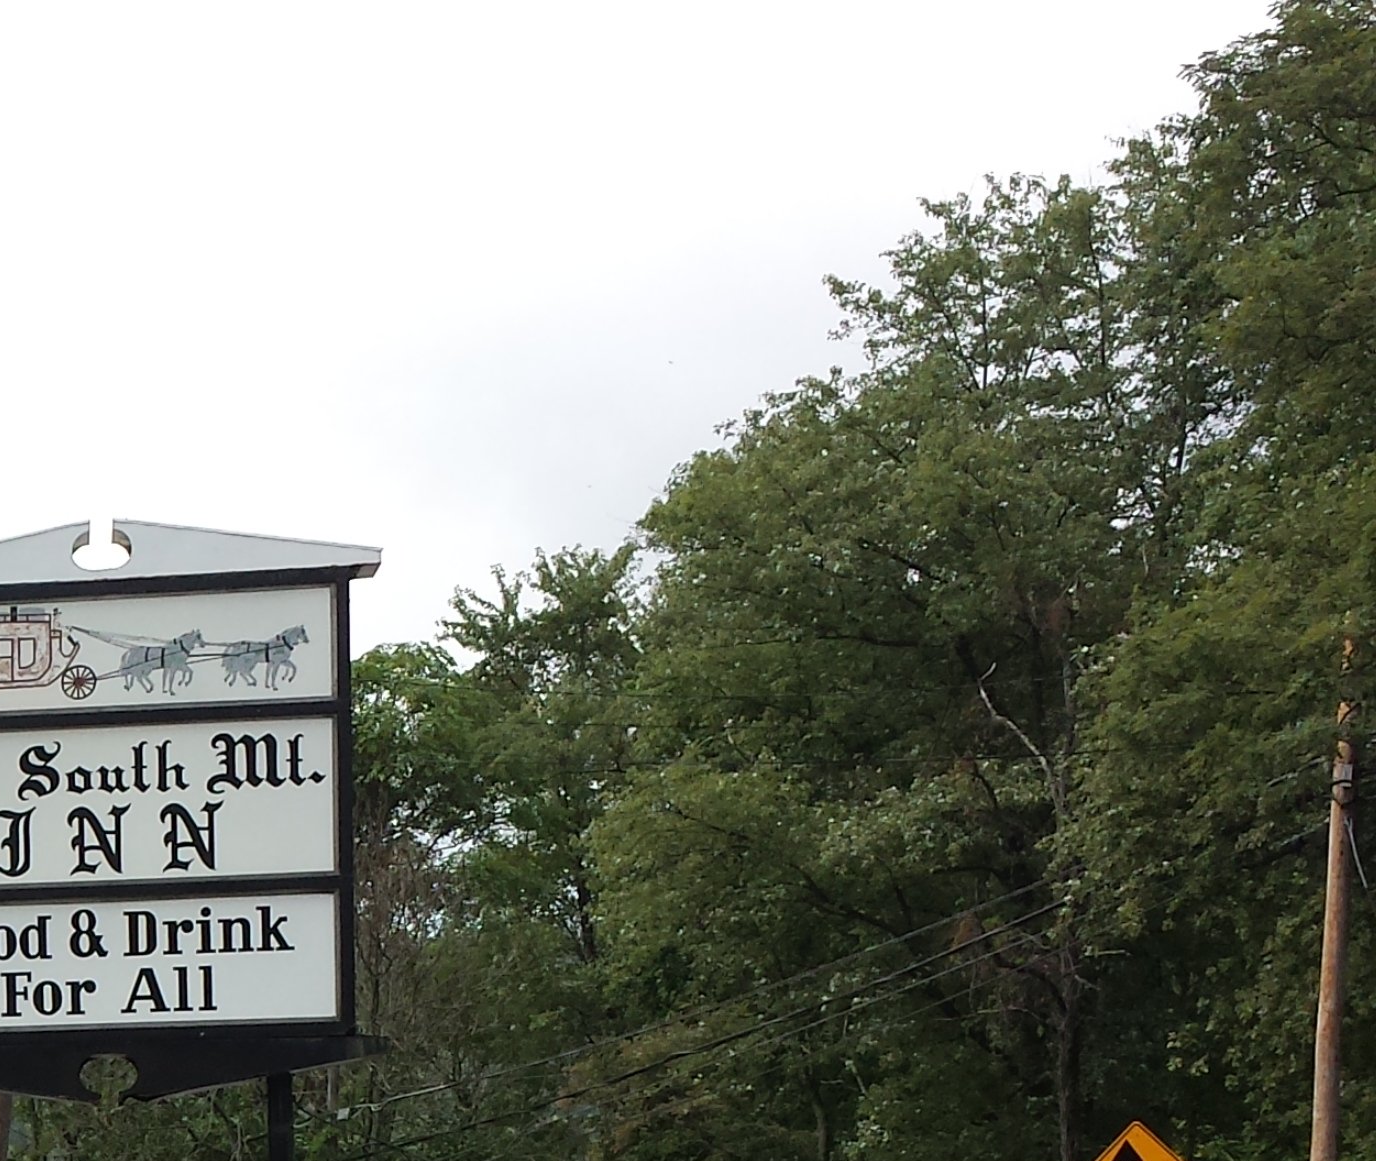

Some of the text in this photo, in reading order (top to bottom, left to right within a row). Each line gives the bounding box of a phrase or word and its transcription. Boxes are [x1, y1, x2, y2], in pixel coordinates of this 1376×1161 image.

[17, 740, 189, 800] South
[206, 733, 327, 794] Mt.
[69, 909, 108, 959] &
[122, 906, 295, 957] Drink
[0, 965, 218, 1017] For All
